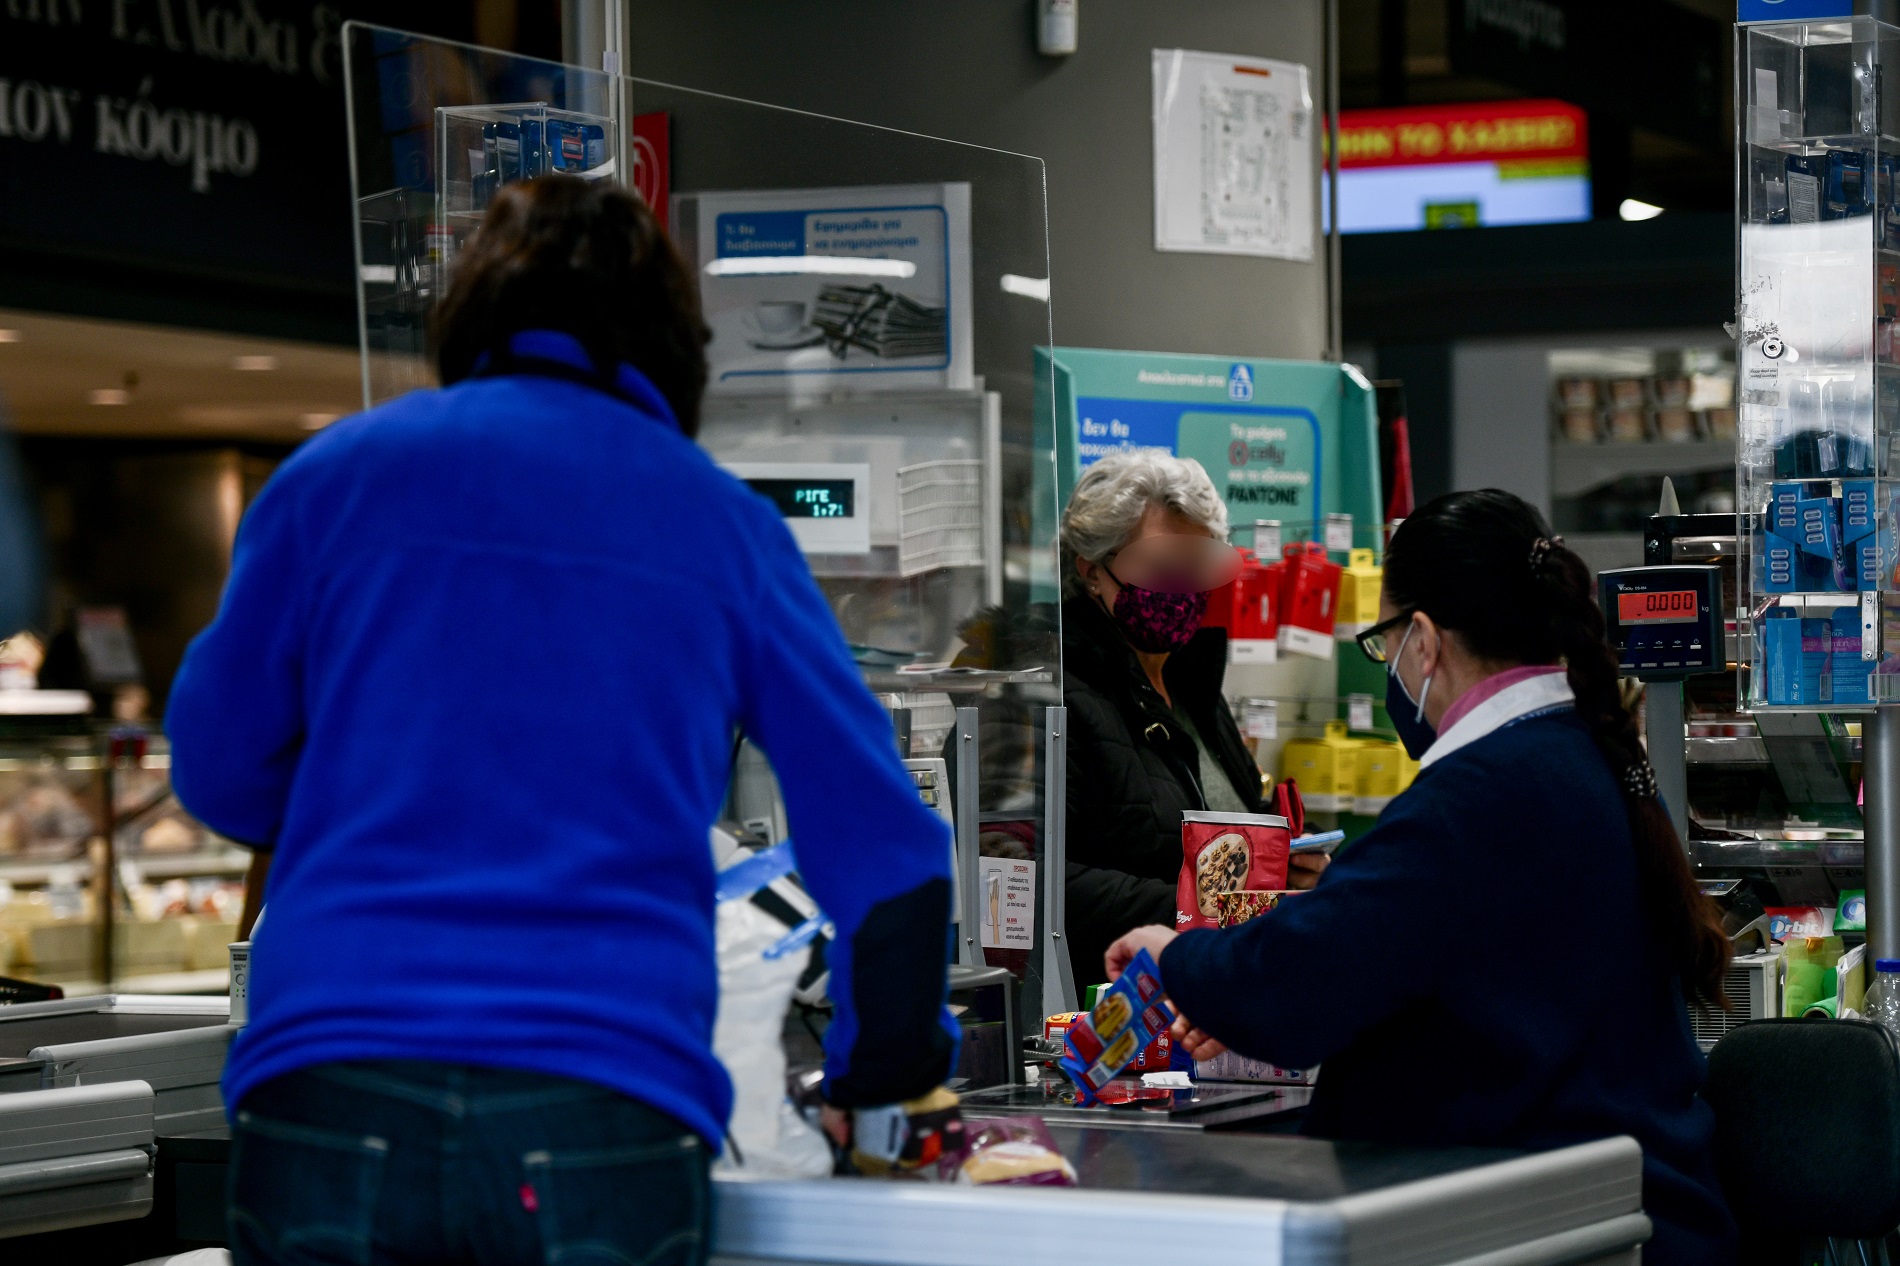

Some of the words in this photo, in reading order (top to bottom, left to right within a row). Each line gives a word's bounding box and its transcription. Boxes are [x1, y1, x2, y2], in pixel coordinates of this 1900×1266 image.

[93, 73, 261, 194] κόσμο
[1082, 417, 1109, 437] δεν
[1110, 418, 1130, 438] θα
[1227, 484, 1300, 506] PANTONE
